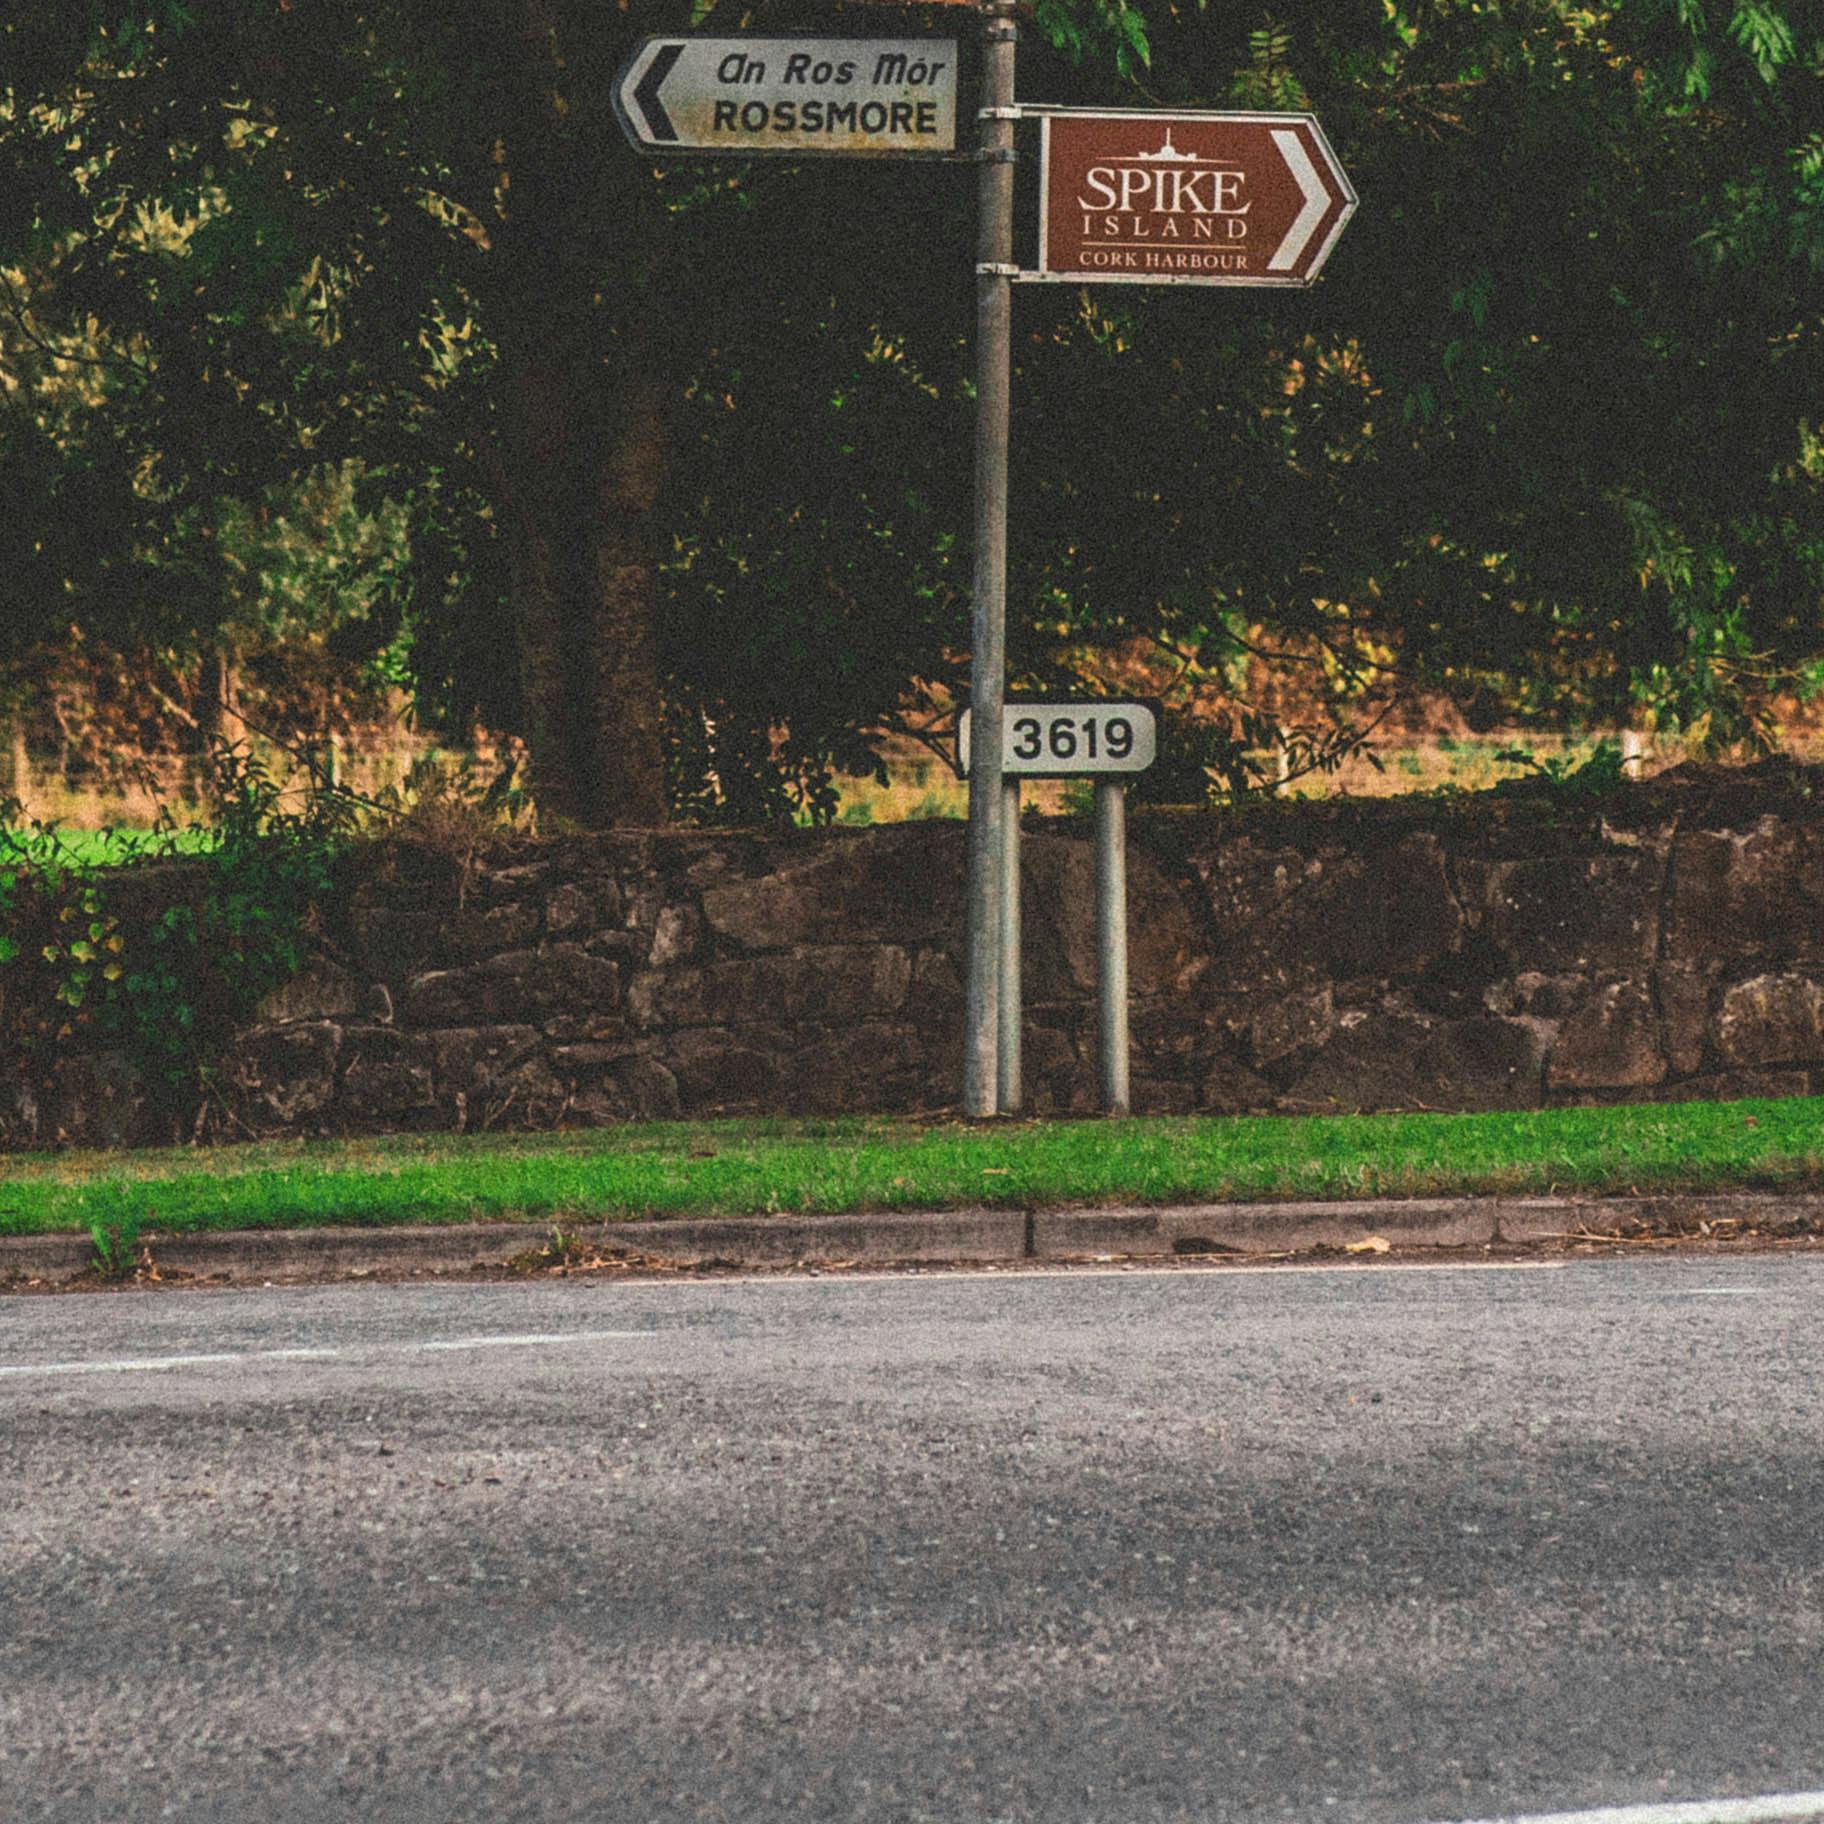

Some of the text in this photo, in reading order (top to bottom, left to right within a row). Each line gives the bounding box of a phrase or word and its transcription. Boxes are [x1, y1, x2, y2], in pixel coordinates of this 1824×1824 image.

[717, 52, 946, 85] An Ros Mór
[713, 100, 937, 134] ROSSMORE
[1077, 167, 1253, 215] SPIKE
[1082, 215, 1248, 239] ISLAND
[1079, 251, 1249, 270] CORK HARBOUR
[1013, 717, 1133, 760] 3619
